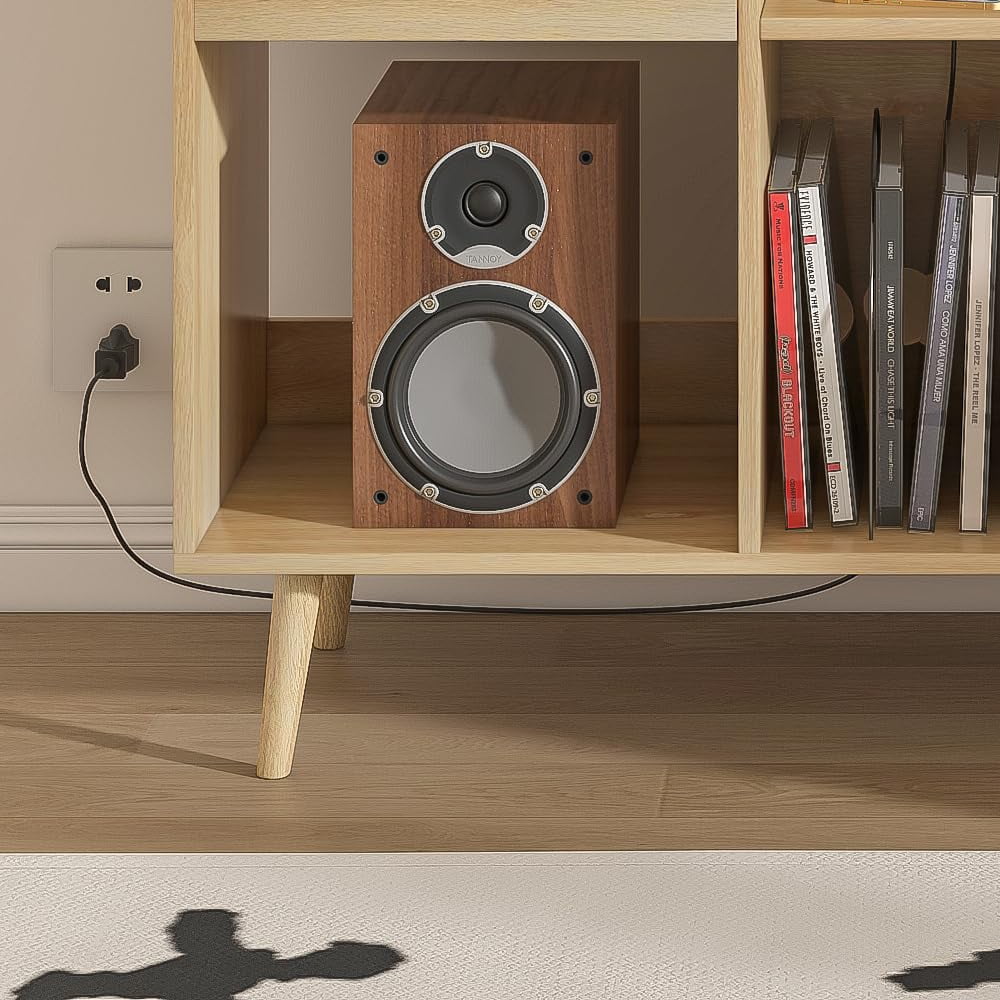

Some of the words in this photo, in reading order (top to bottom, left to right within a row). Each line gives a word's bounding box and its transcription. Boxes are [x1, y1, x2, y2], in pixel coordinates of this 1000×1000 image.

[466, 255, 502, 263] TANNOY
[806, 250, 816, 285] HOWARD
[946, 244, 957, 279] JENNIFER
[886, 285, 894, 309] JIMMY
[943, 280, 954, 304] LOPEZ
[813, 311, 821, 335] WHITE
[887, 309, 895, 323] EAT
[939, 310, 950, 337] COMO
[974, 300, 983, 338] JENNIFER
[815, 337, 824, 358] BOYS
[887, 325, 895, 353] WORLD
[937, 339, 947, 357] AMA
[973, 341, 981, 366] LOPEZ
[887, 359, 895, 386] CHASE
[935, 359, 945, 375] UNA
[932, 377, 943, 403] MUJER
[972, 372, 980, 388] THE
[887, 387, 895, 405] THIS
[781, 379, 795, 438] BLACKOUT
[887, 406, 895, 428] LIGHT
[971, 413, 979, 424] ME
[824, 423, 832, 435] On
[826, 437, 834, 458] Blues
